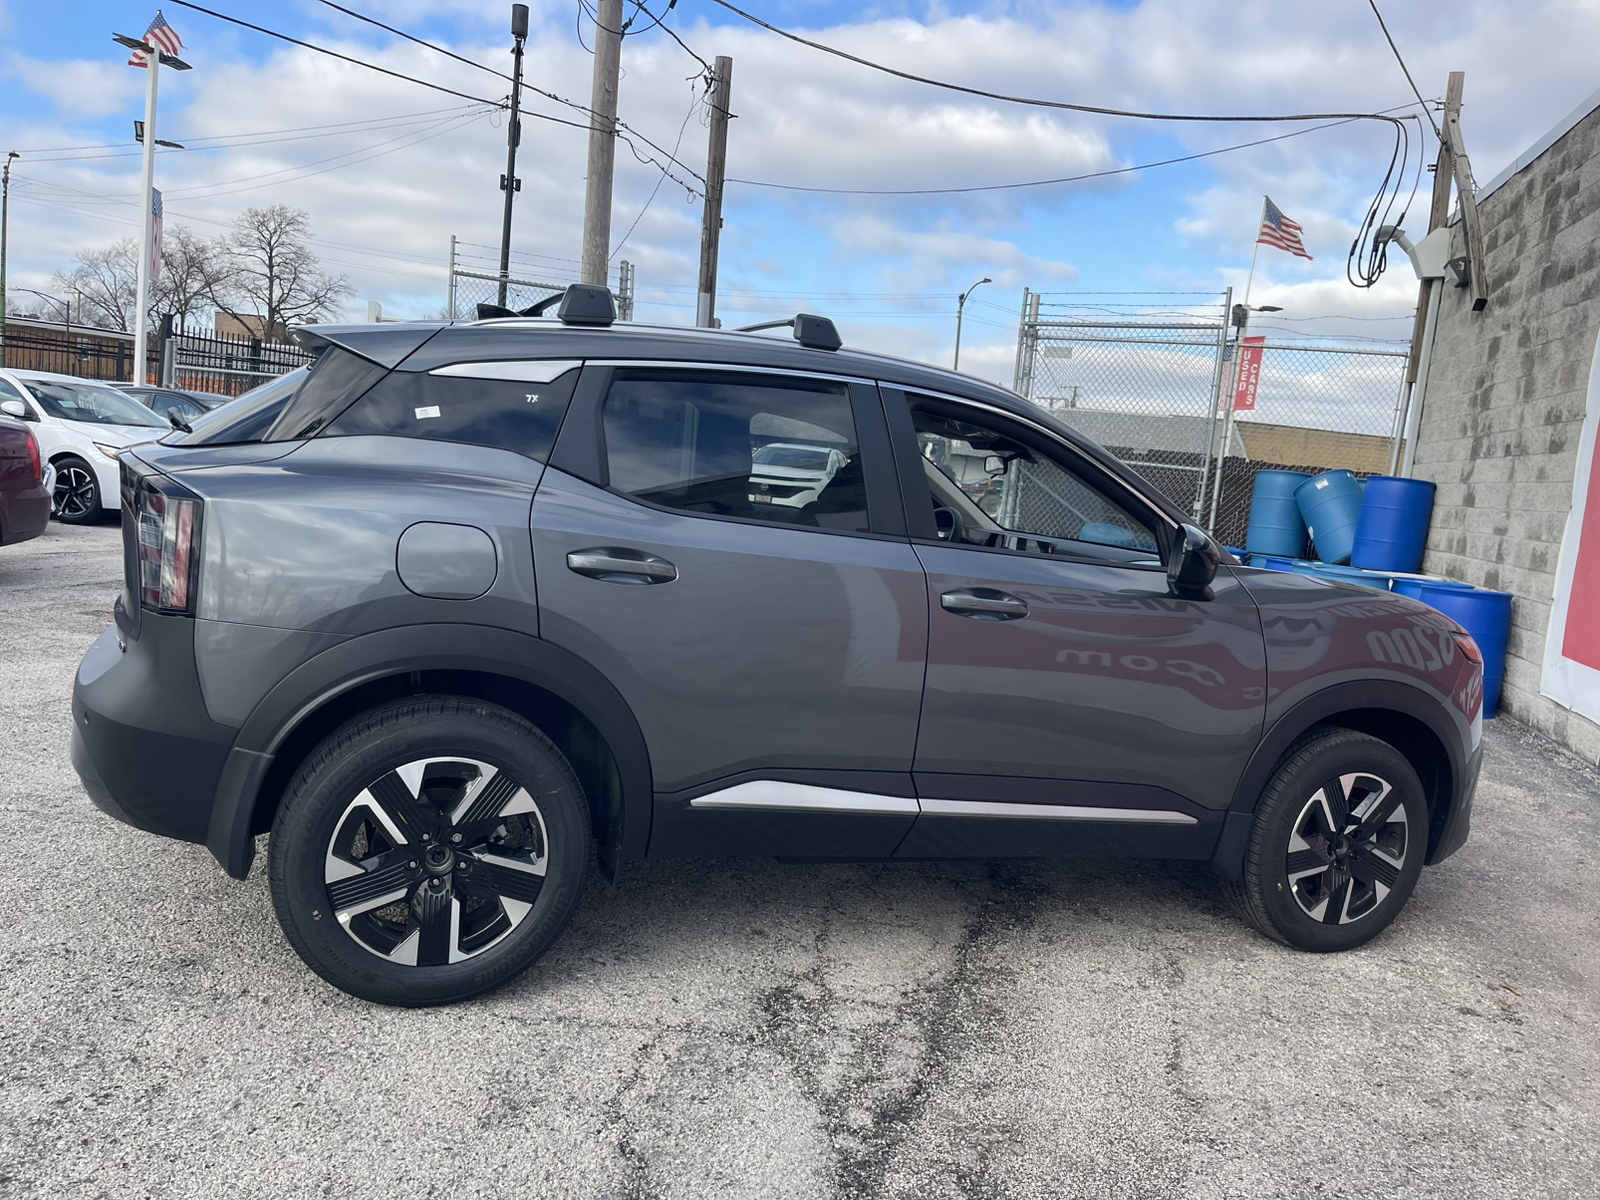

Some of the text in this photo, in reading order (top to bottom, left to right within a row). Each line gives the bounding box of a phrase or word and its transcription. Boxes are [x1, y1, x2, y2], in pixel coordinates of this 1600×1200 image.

[1239, 351, 1251, 391] USED
[1246, 364, 1258, 404] CARS
[473, 888, 572, 987] BRIDGESTONE
